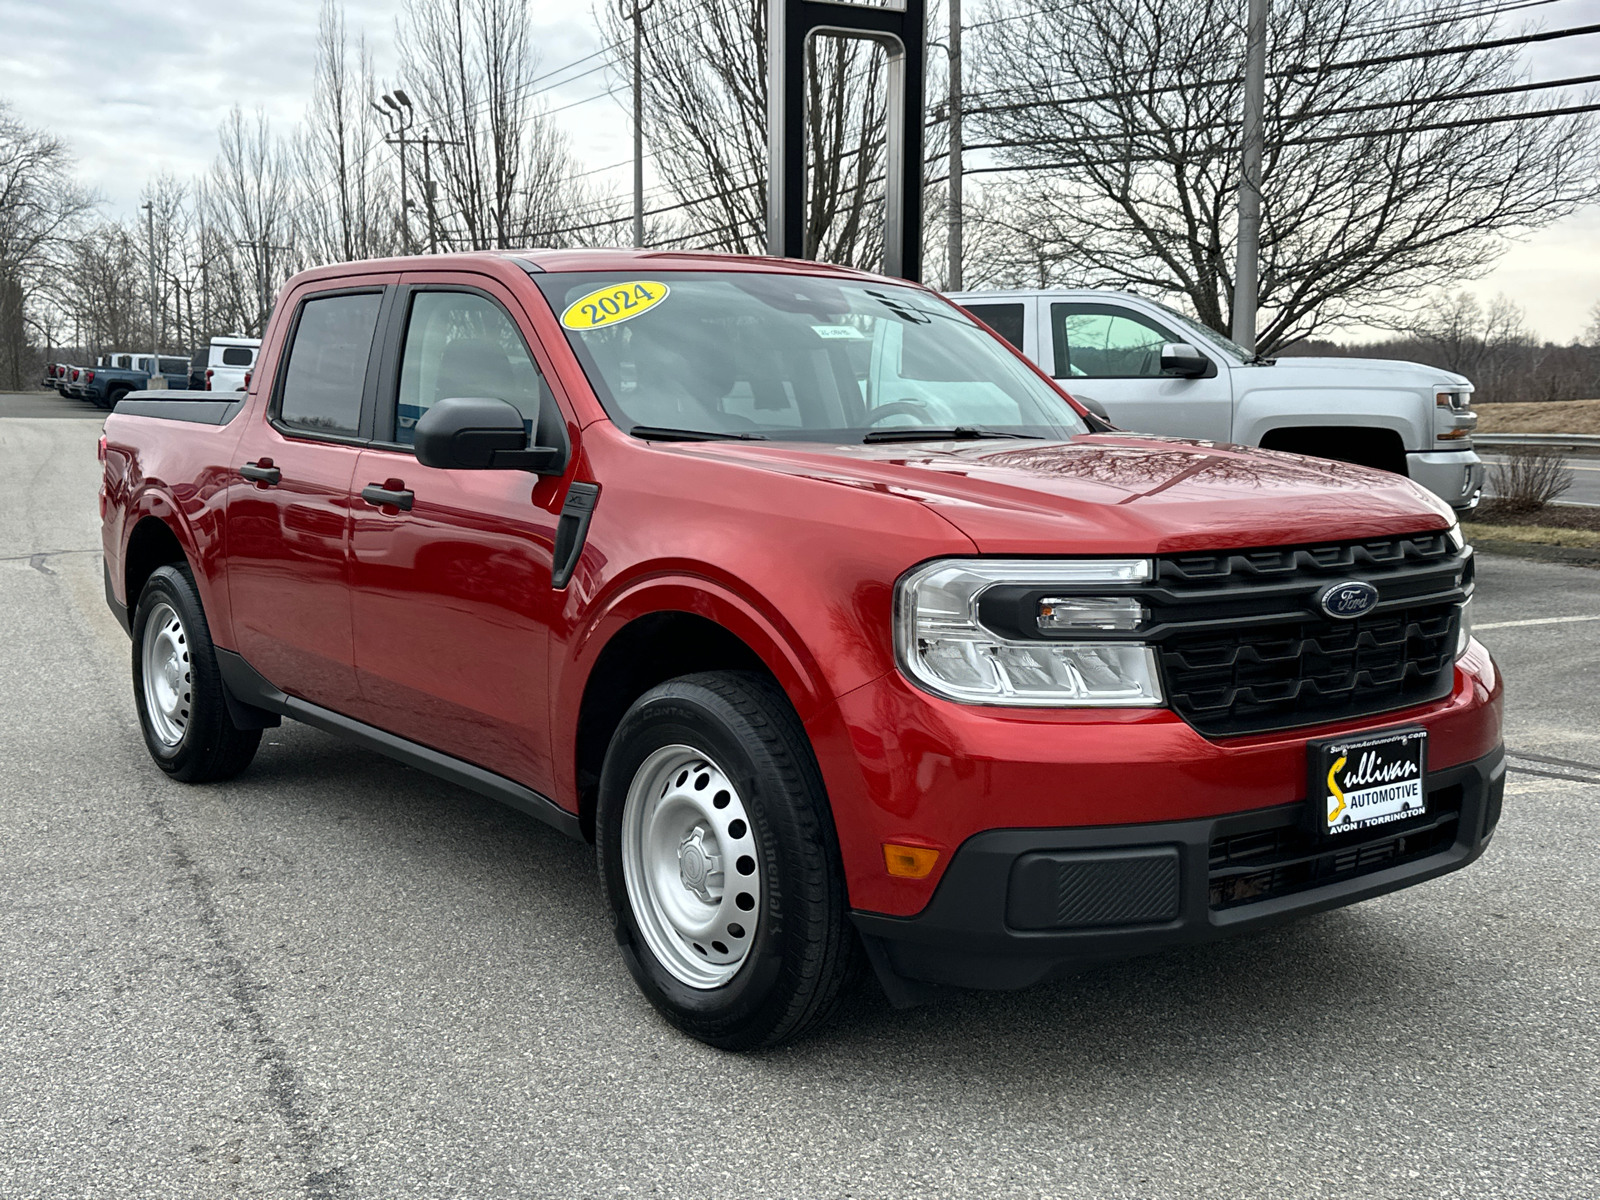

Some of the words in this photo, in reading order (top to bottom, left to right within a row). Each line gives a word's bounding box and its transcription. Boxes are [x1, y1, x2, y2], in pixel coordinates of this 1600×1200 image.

[581, 284, 655, 324] 2024
[1338, 589, 1369, 611] Ford
[1330, 731, 1427, 754] SullivanAutomotive.com
[1327, 750, 1418, 822] Sullivan
[1350, 783, 1418, 809] AUTOMOTIVE
[1329, 822, 1358, 835] AVON
[1366, 806, 1426, 827] TORRINGTON
